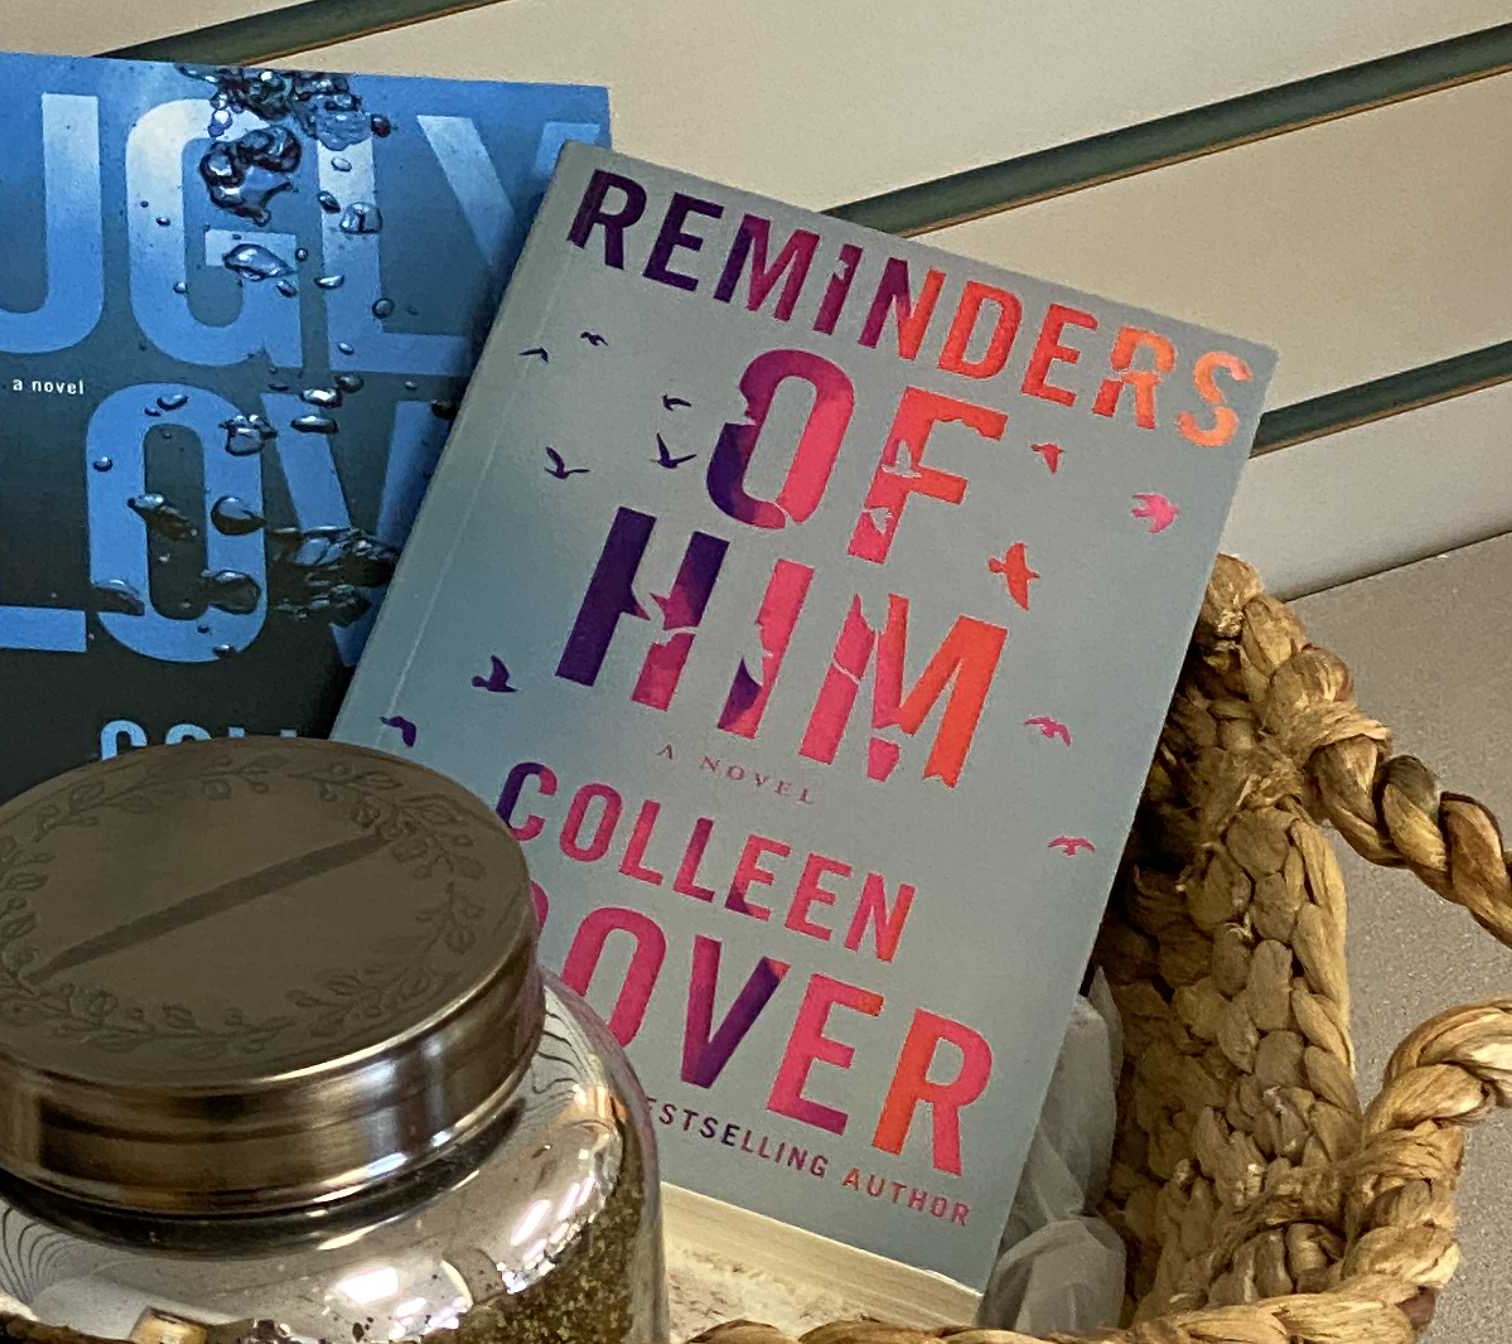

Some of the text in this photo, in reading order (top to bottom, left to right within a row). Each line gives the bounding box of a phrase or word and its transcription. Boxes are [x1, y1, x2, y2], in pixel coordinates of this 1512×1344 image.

[12, 378, 85, 395] a novel
[568, 169, 1255, 448] REMINDERS
[706, 349, 1008, 565] OF
[555, 507, 1008, 789] HIM
[496, 761, 916, 963] COLLEEN
[656, 743, 816, 805] A NOVEL
[529, 880, 994, 1177] OVER
[645, 1096, 970, 1227] STSELLING AUTHOR
